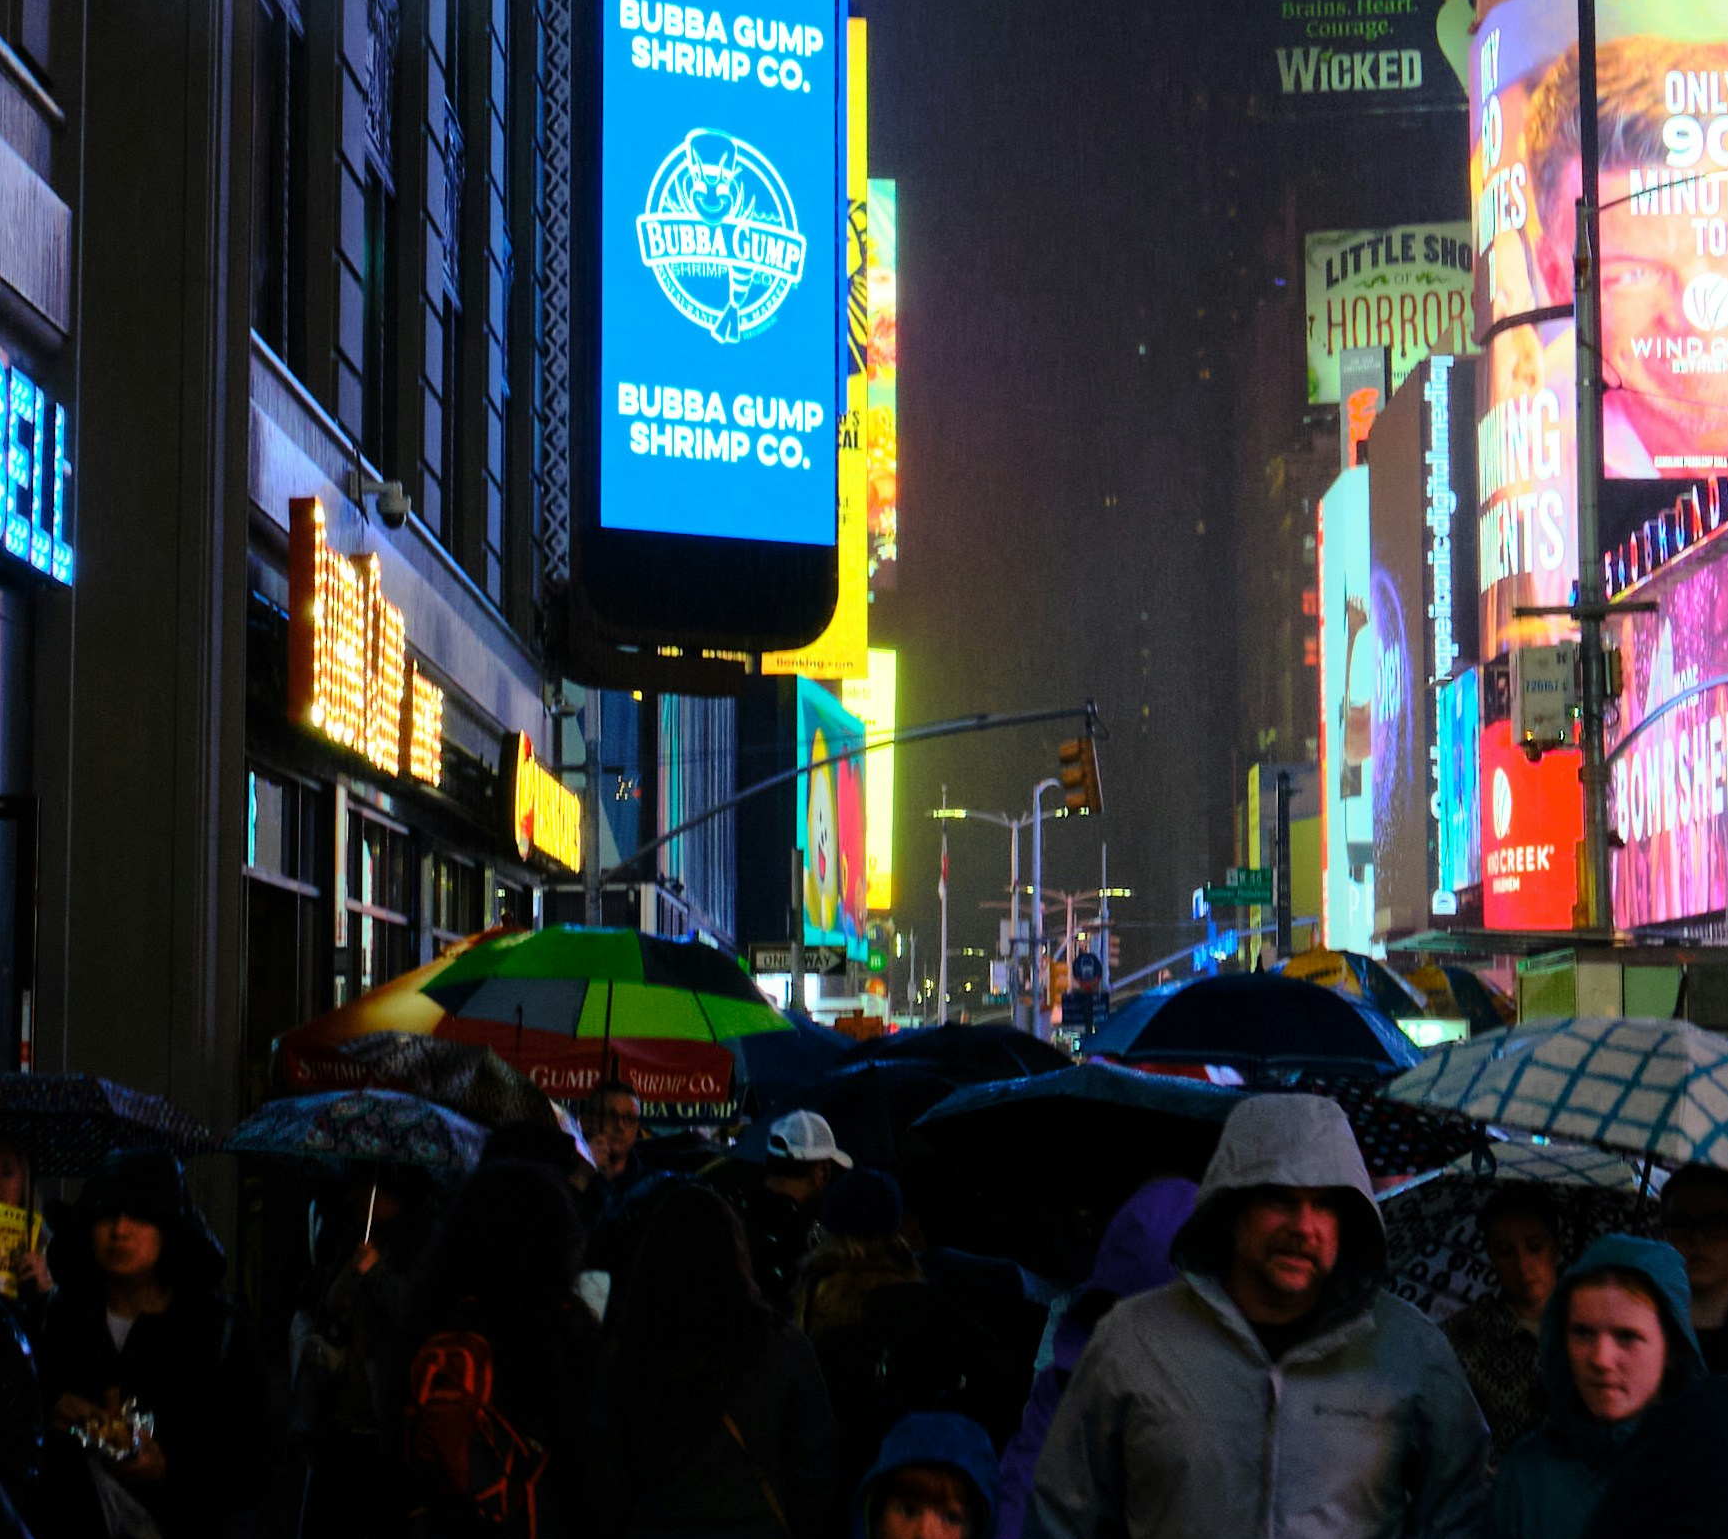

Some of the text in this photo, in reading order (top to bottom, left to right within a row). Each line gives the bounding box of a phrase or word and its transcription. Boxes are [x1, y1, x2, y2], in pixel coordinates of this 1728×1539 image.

[732, 13, 824, 57] GUMP
[1305, 18, 1394, 42] Courage.
[631, 36, 811, 93] SHRIMP CO.
[646, 221, 802, 272] BUBBA GUMP
[1691, 218, 1728, 256] TO
[1326, 231, 1417, 290] LITTLE
[1631, 336, 1704, 359] WIND
[617, 381, 824, 434] BUBBA GUMP
[629, 423, 811, 469] SHRIMP CO.
[804, 952, 832, 968] WAY
[296, 1059, 369, 1082] SHRIMP
[530, 1064, 601, 1090] GUMP
[629, 1066, 722, 1095] SHRIMP CO.
[675, 1099, 739, 1120] GUMP
